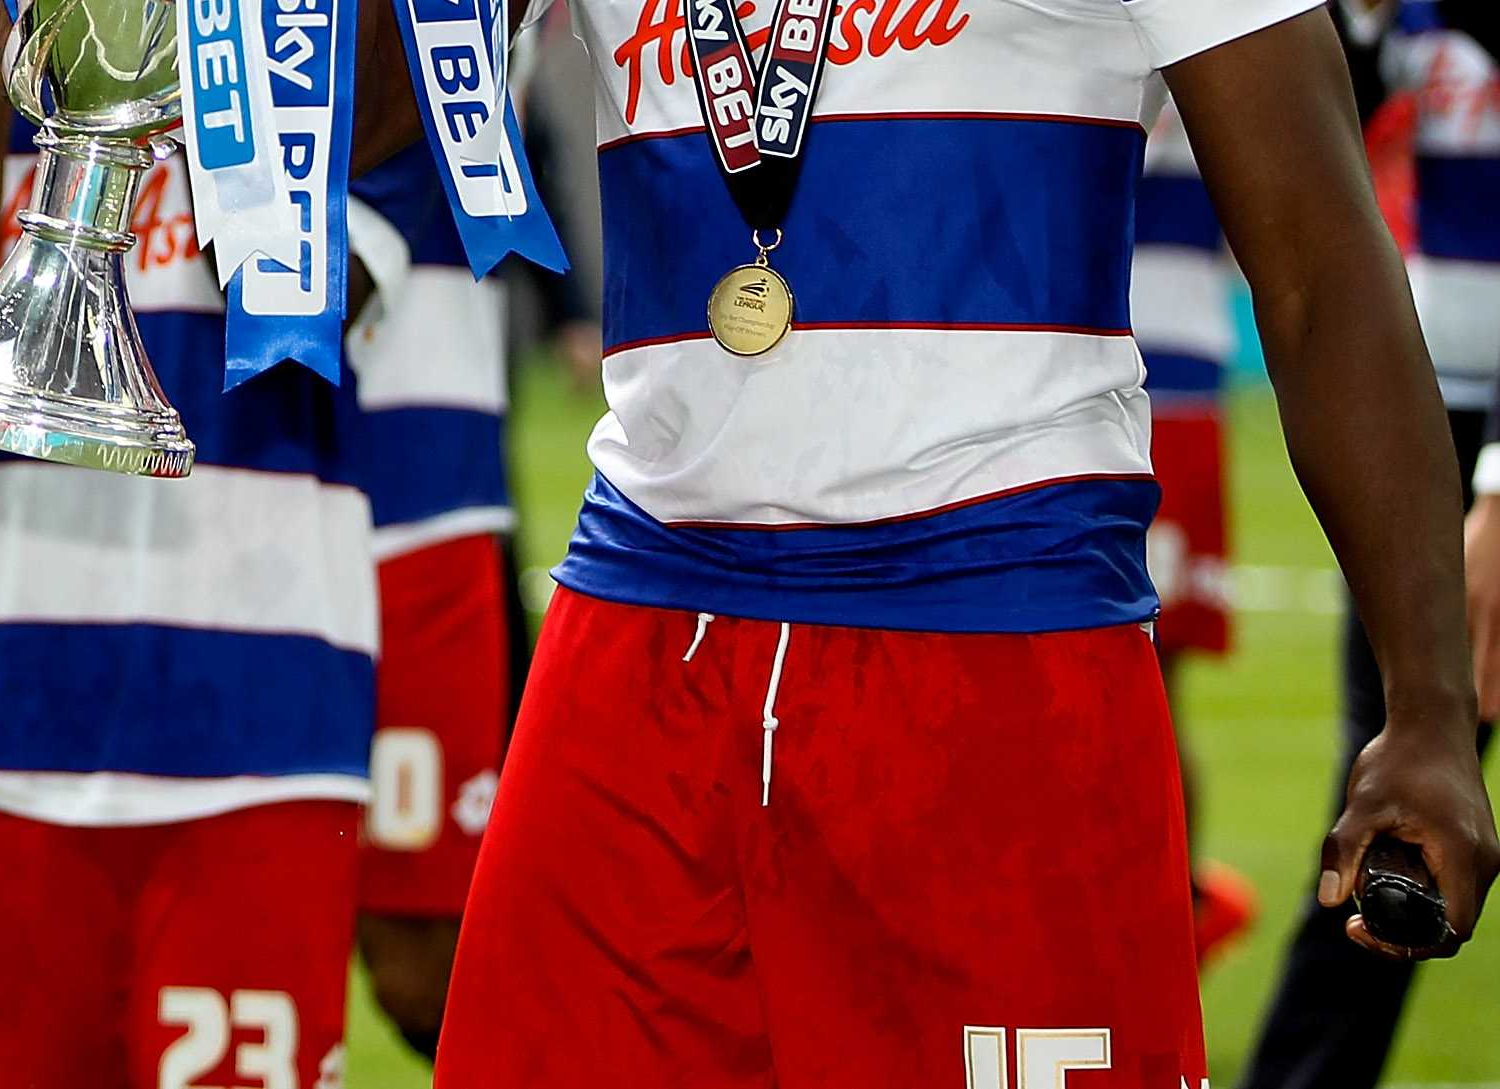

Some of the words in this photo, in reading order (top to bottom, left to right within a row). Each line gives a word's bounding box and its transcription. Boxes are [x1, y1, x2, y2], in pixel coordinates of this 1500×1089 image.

[707, 55, 755, 149] BET
[756, 65, 809, 144] sky
[157, 985, 299, 1089] 23
